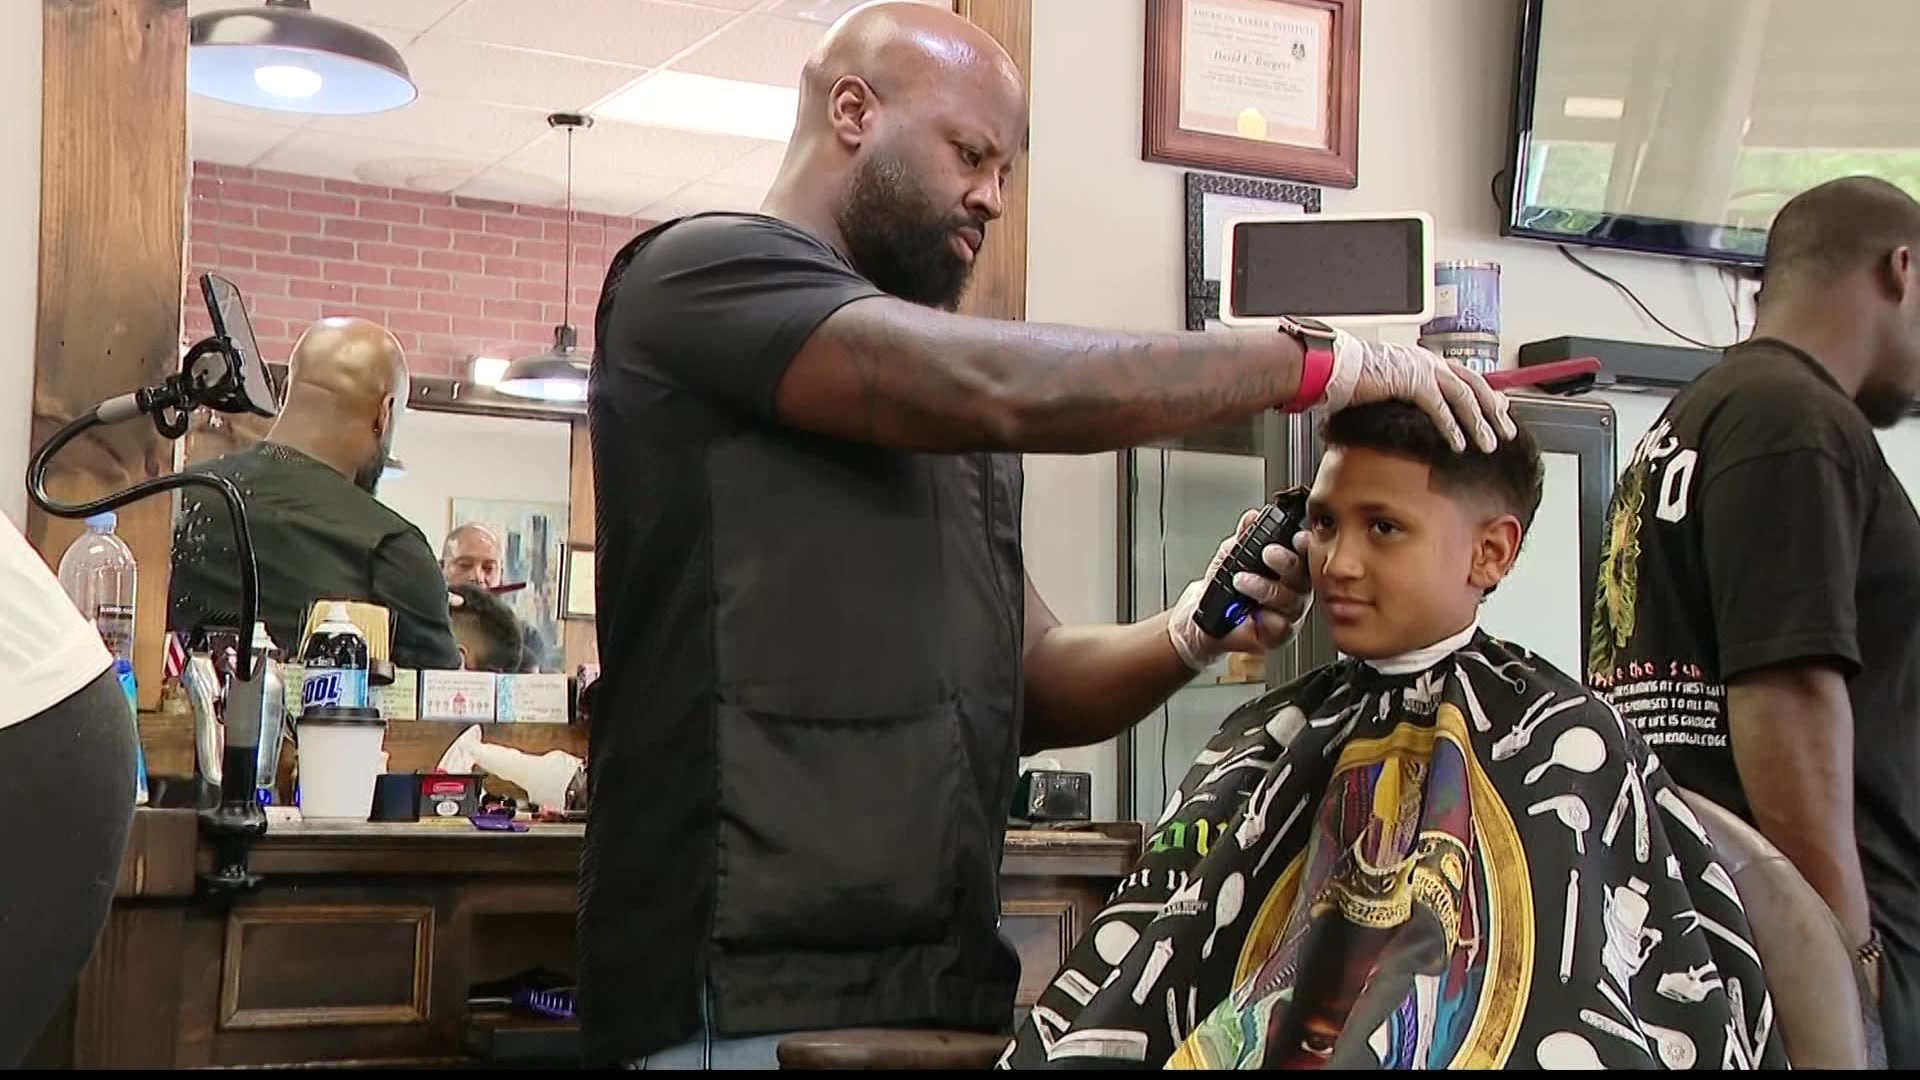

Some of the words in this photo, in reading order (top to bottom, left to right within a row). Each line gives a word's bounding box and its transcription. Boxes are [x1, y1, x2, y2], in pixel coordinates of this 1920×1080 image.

[1670, 698, 1684, 709] TO
[1668, 714, 1679, 726] IS
[1665, 732, 1727, 746] KNOWLEDGE
